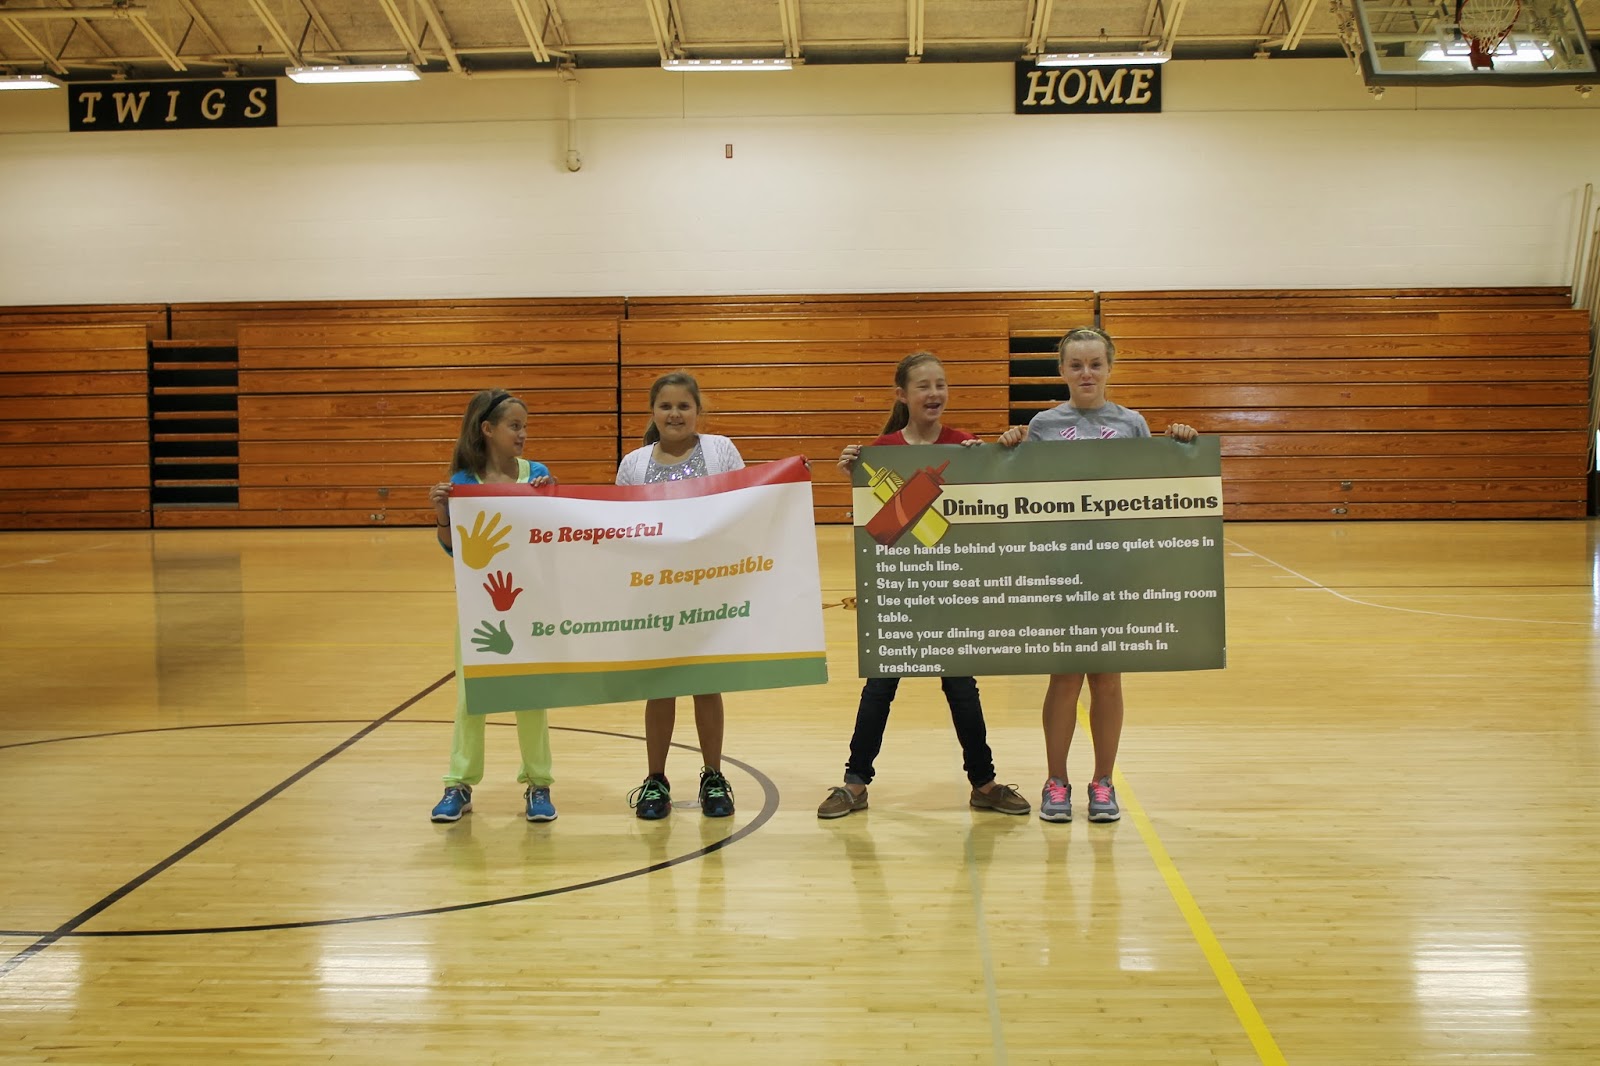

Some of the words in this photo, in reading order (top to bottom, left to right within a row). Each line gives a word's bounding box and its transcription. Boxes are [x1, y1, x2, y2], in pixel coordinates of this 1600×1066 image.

[1022, 68, 1154, 106] HOME
[78, 87, 268, 124] TWIGS
[943, 499, 1008, 519] Dining
[1015, 497, 1074, 514] Room
[1081, 493, 1217, 516] Expectations
[529, 528, 554, 544] Be
[558, 522, 663, 545] Respectful
[875, 544, 911, 556] Place
[913, 544, 952, 555] hands
[953, 542, 996, 554] behind
[998, 544, 1027, 556] your
[1029, 540, 1068, 552] backs
[1069, 539, 1094, 551] and
[1096, 541, 1120, 550] use
[1122, 537, 1155, 552] quiet
[1157, 536, 1200, 549] voices
[1202, 535, 1215, 547] in
[630, 571, 655, 587] Be
[659, 556, 773, 585] Responsible
[875, 561, 897, 573] the
[899, 560, 934, 572] lunch
[936, 560, 964, 571] line.
[876, 577, 905, 592] Stay
[907, 577, 920, 589] in
[921, 579, 950, 592] your
[952, 577, 981, 588] seat
[983, 575, 1013, 587] until
[1014, 573, 1084, 587] dismissed.
[876, 594, 901, 607] Use
[903, 594, 936, 609] quiet
[937, 593, 980, 605] voices
[982, 592, 1006, 604] and
[1007, 593, 1063, 604] manners
[1065, 590, 1100, 602] while
[1102, 590, 1116, 601] at
[1118, 589, 1140, 601] the
[1142, 588, 1182, 602] dining
[1184, 589, 1217, 599] room
[531, 621, 556, 637] Be
[560, 611, 674, 635] Community
[678, 601, 750, 625] Minded
[877, 611, 913, 623] table.
[877, 628, 914, 640] Leave
[916, 630, 944, 642] your
[946, 627, 985, 641] dining
[987, 628, 1016, 638] area
[1018, 625, 1066, 637] cleaner
[1068, 624, 1098, 636] than
[1100, 626, 1124, 638] you
[1126, 622, 1163, 635] found
[1165, 622, 1179, 633] it.
[878, 644, 919, 659] Gently
[920, 644, 955, 659] place
[957, 643, 1022, 656] silverware
[1024, 642, 1051, 654] into
[1052, 641, 1073, 653] bin
[1074, 640, 1099, 653] and
[1100, 640, 1117, 652] all
[1119, 639, 1154, 651] trash
[1155, 639, 1169, 651] in
[878, 661, 945, 673] trashcans.
